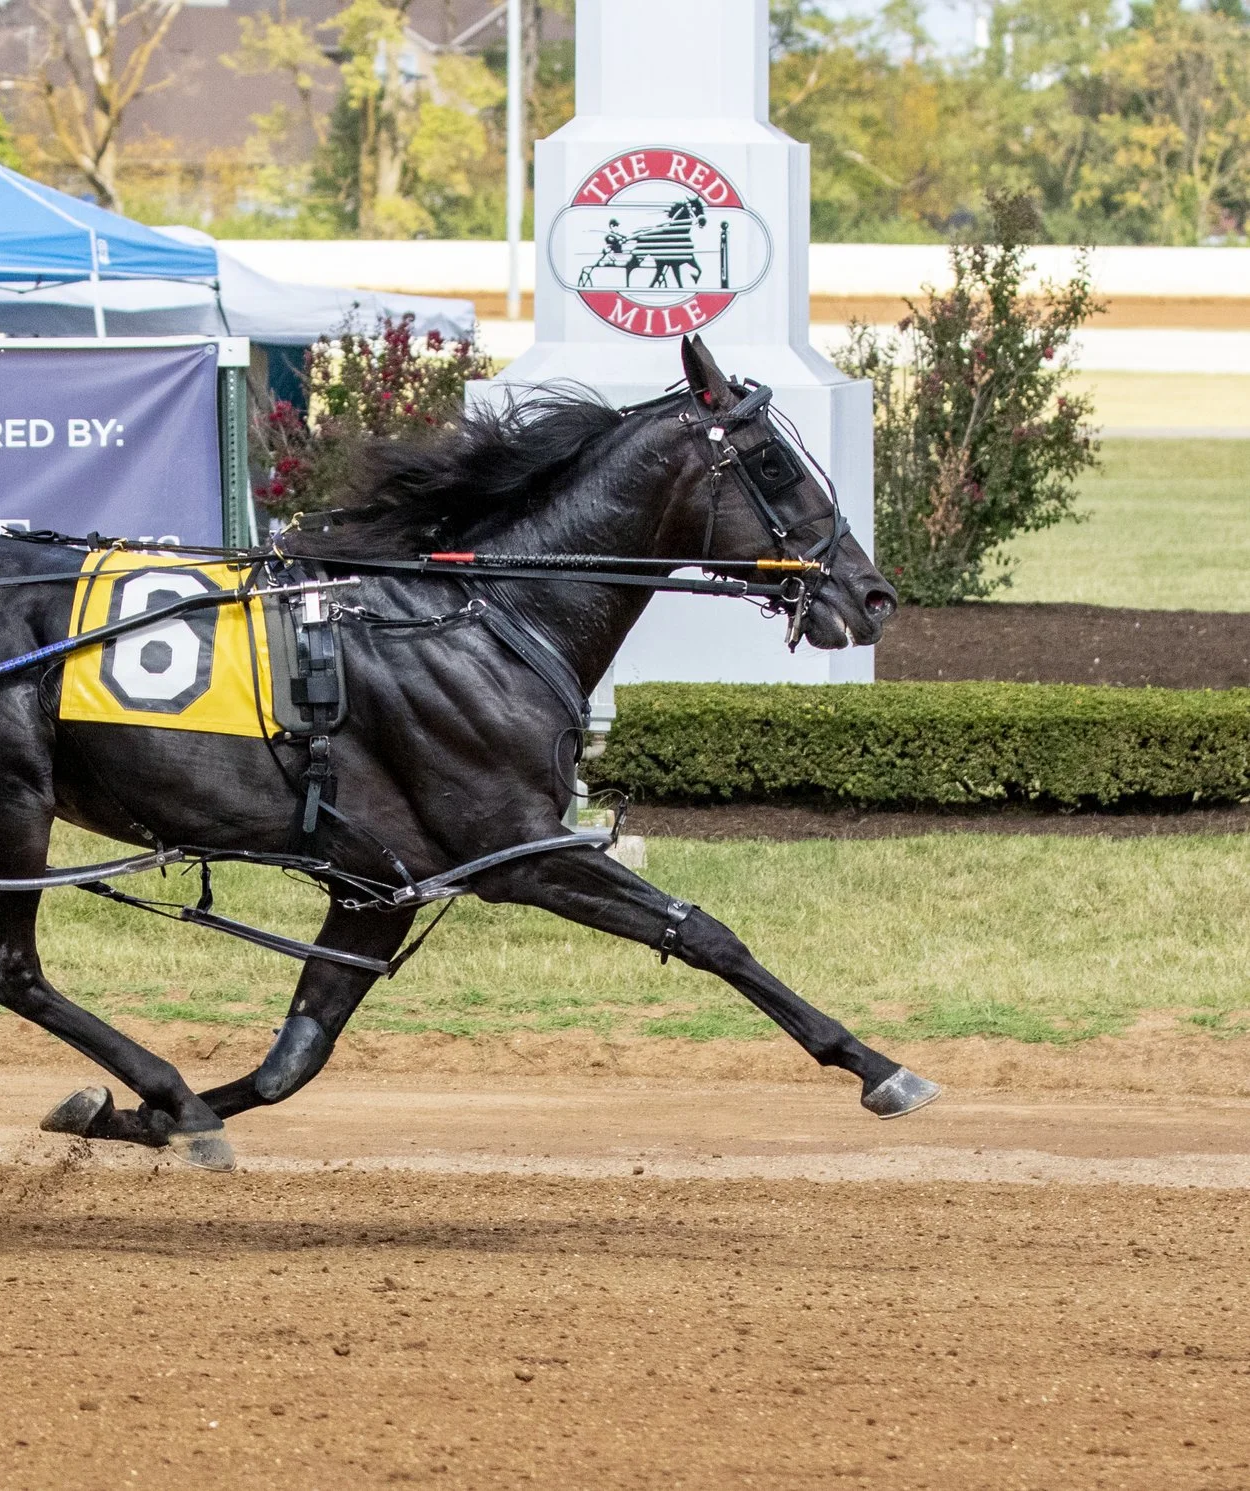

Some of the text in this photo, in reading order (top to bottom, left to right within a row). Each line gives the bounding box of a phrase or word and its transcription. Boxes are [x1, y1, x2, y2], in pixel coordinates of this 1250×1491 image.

[584, 153, 728, 205] THE RED
[608, 298, 706, 334] MILE
[68, 418, 125, 448] BY:
[111, 571, 210, 701] 6
